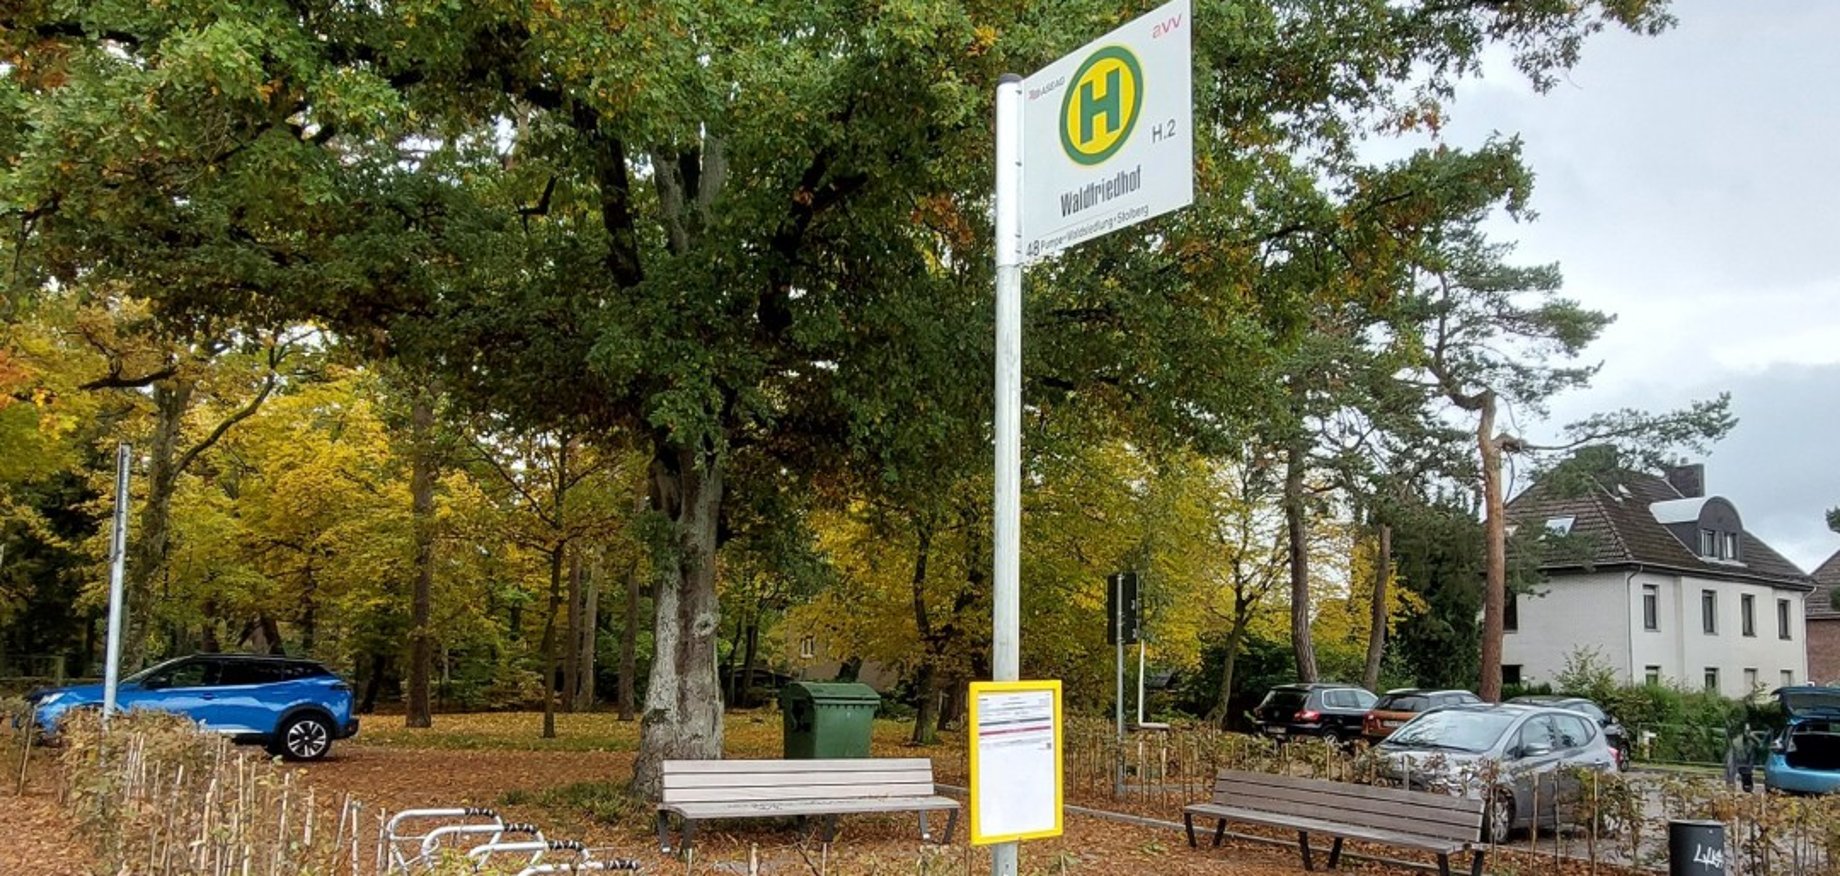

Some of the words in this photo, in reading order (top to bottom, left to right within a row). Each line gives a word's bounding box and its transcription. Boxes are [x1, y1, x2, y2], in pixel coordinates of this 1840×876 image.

[1080, 67, 1120, 145] H
[1152, 118, 1176, 144] H.2
[1060, 164, 1141, 218] Waldfriedhof
